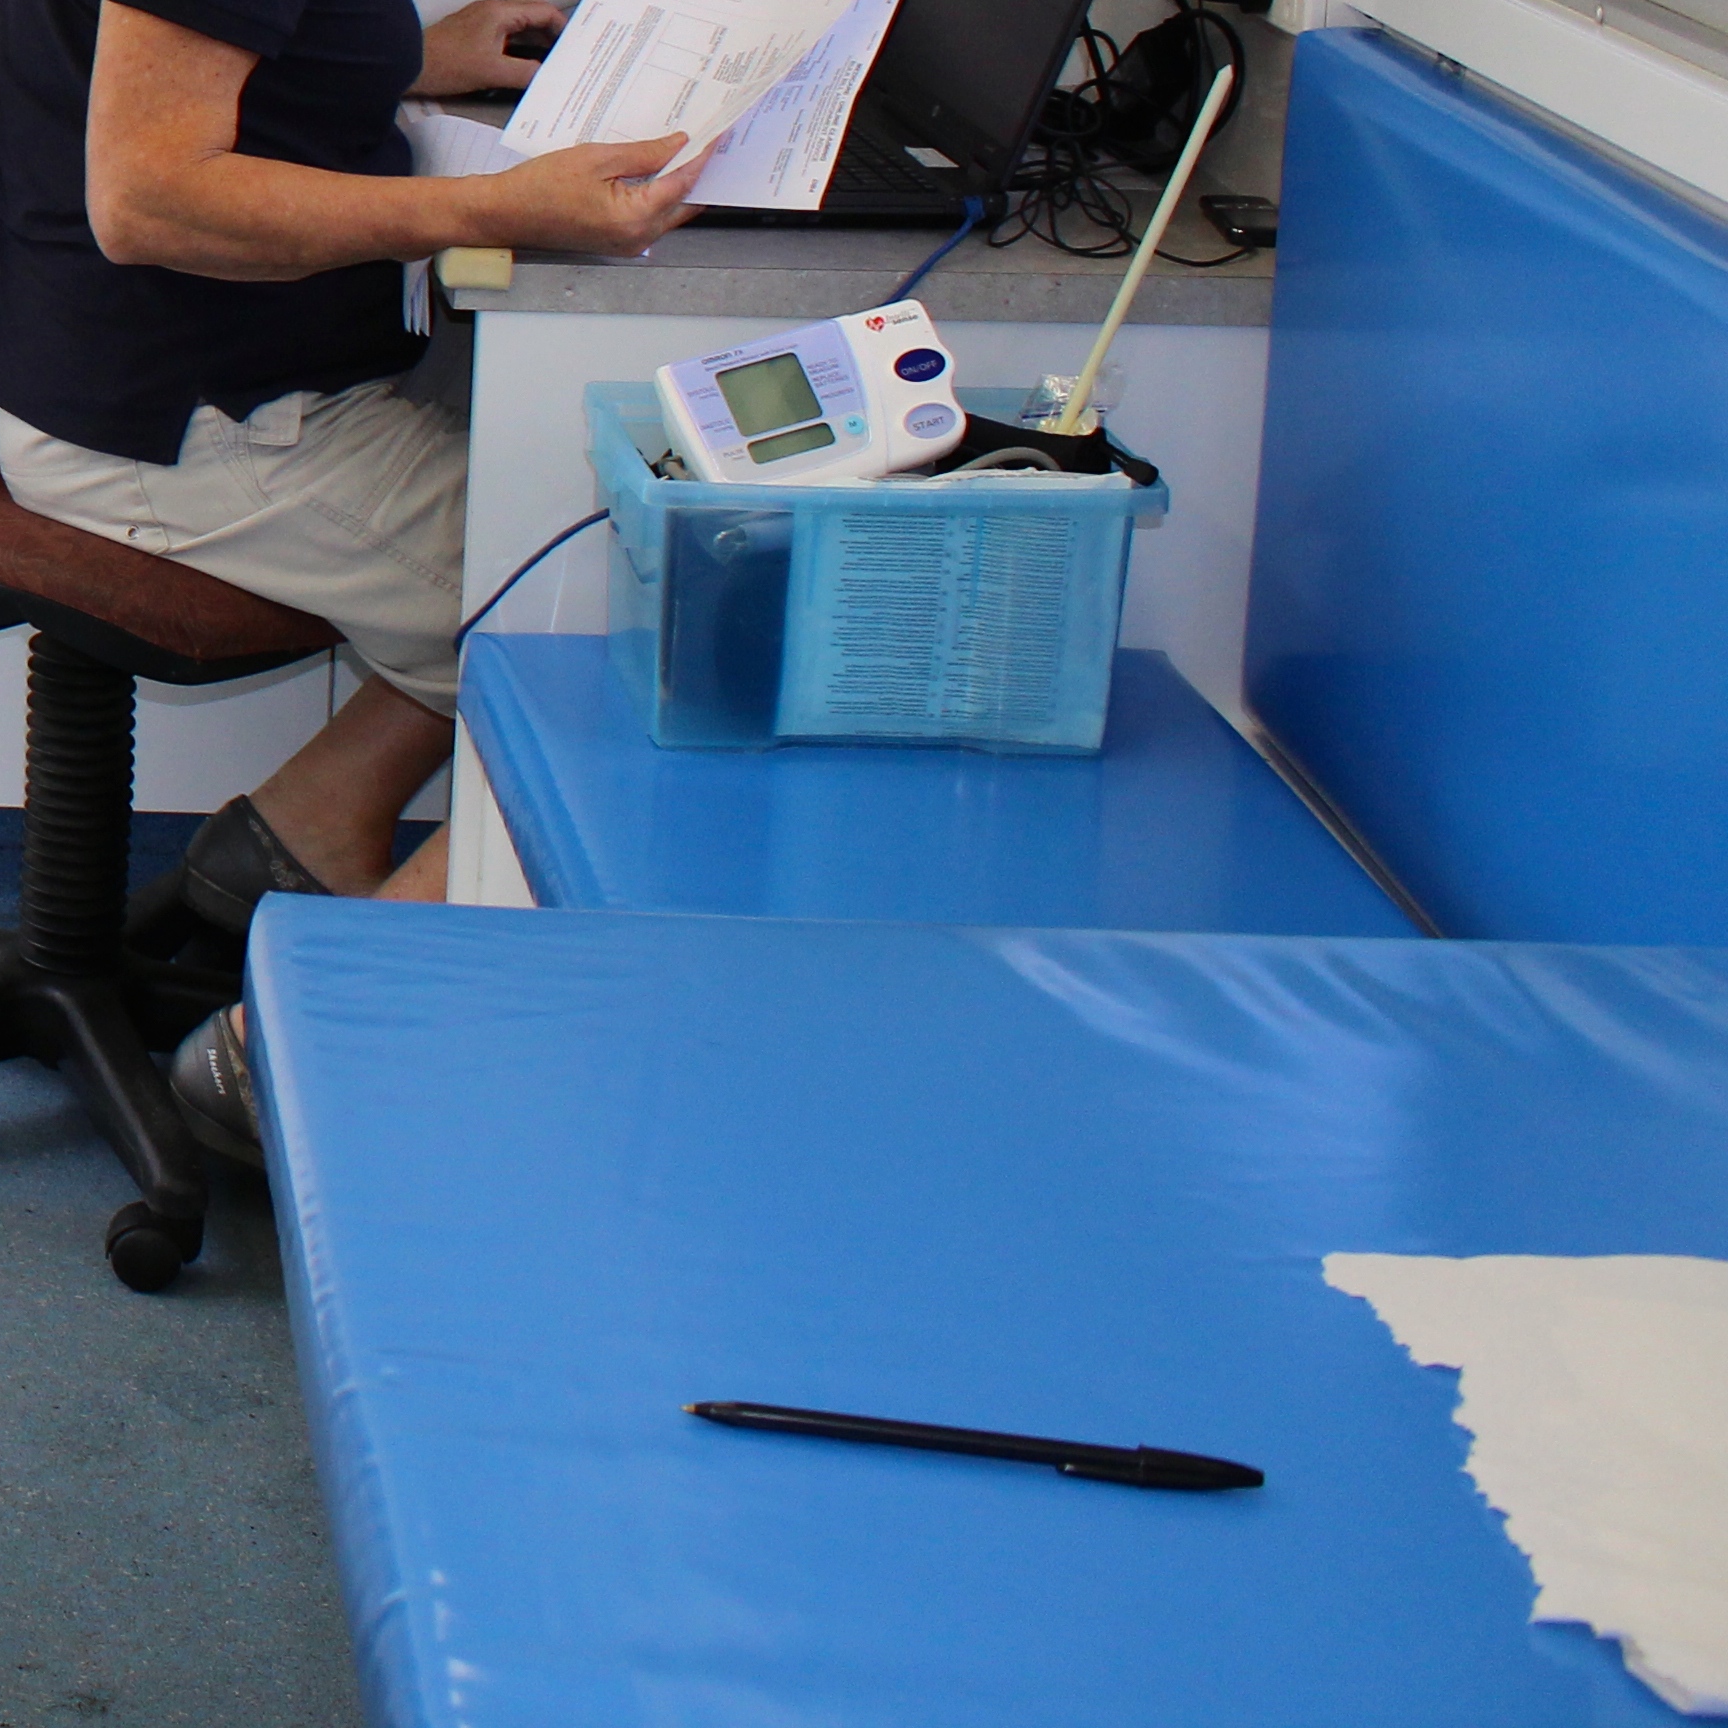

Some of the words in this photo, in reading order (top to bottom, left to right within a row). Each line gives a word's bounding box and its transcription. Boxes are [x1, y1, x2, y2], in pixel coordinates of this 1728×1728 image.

[844, 63, 863, 94] MEDICARE
[902, 360, 937, 375] ON/OFF
[913, 416, 943, 431] START
